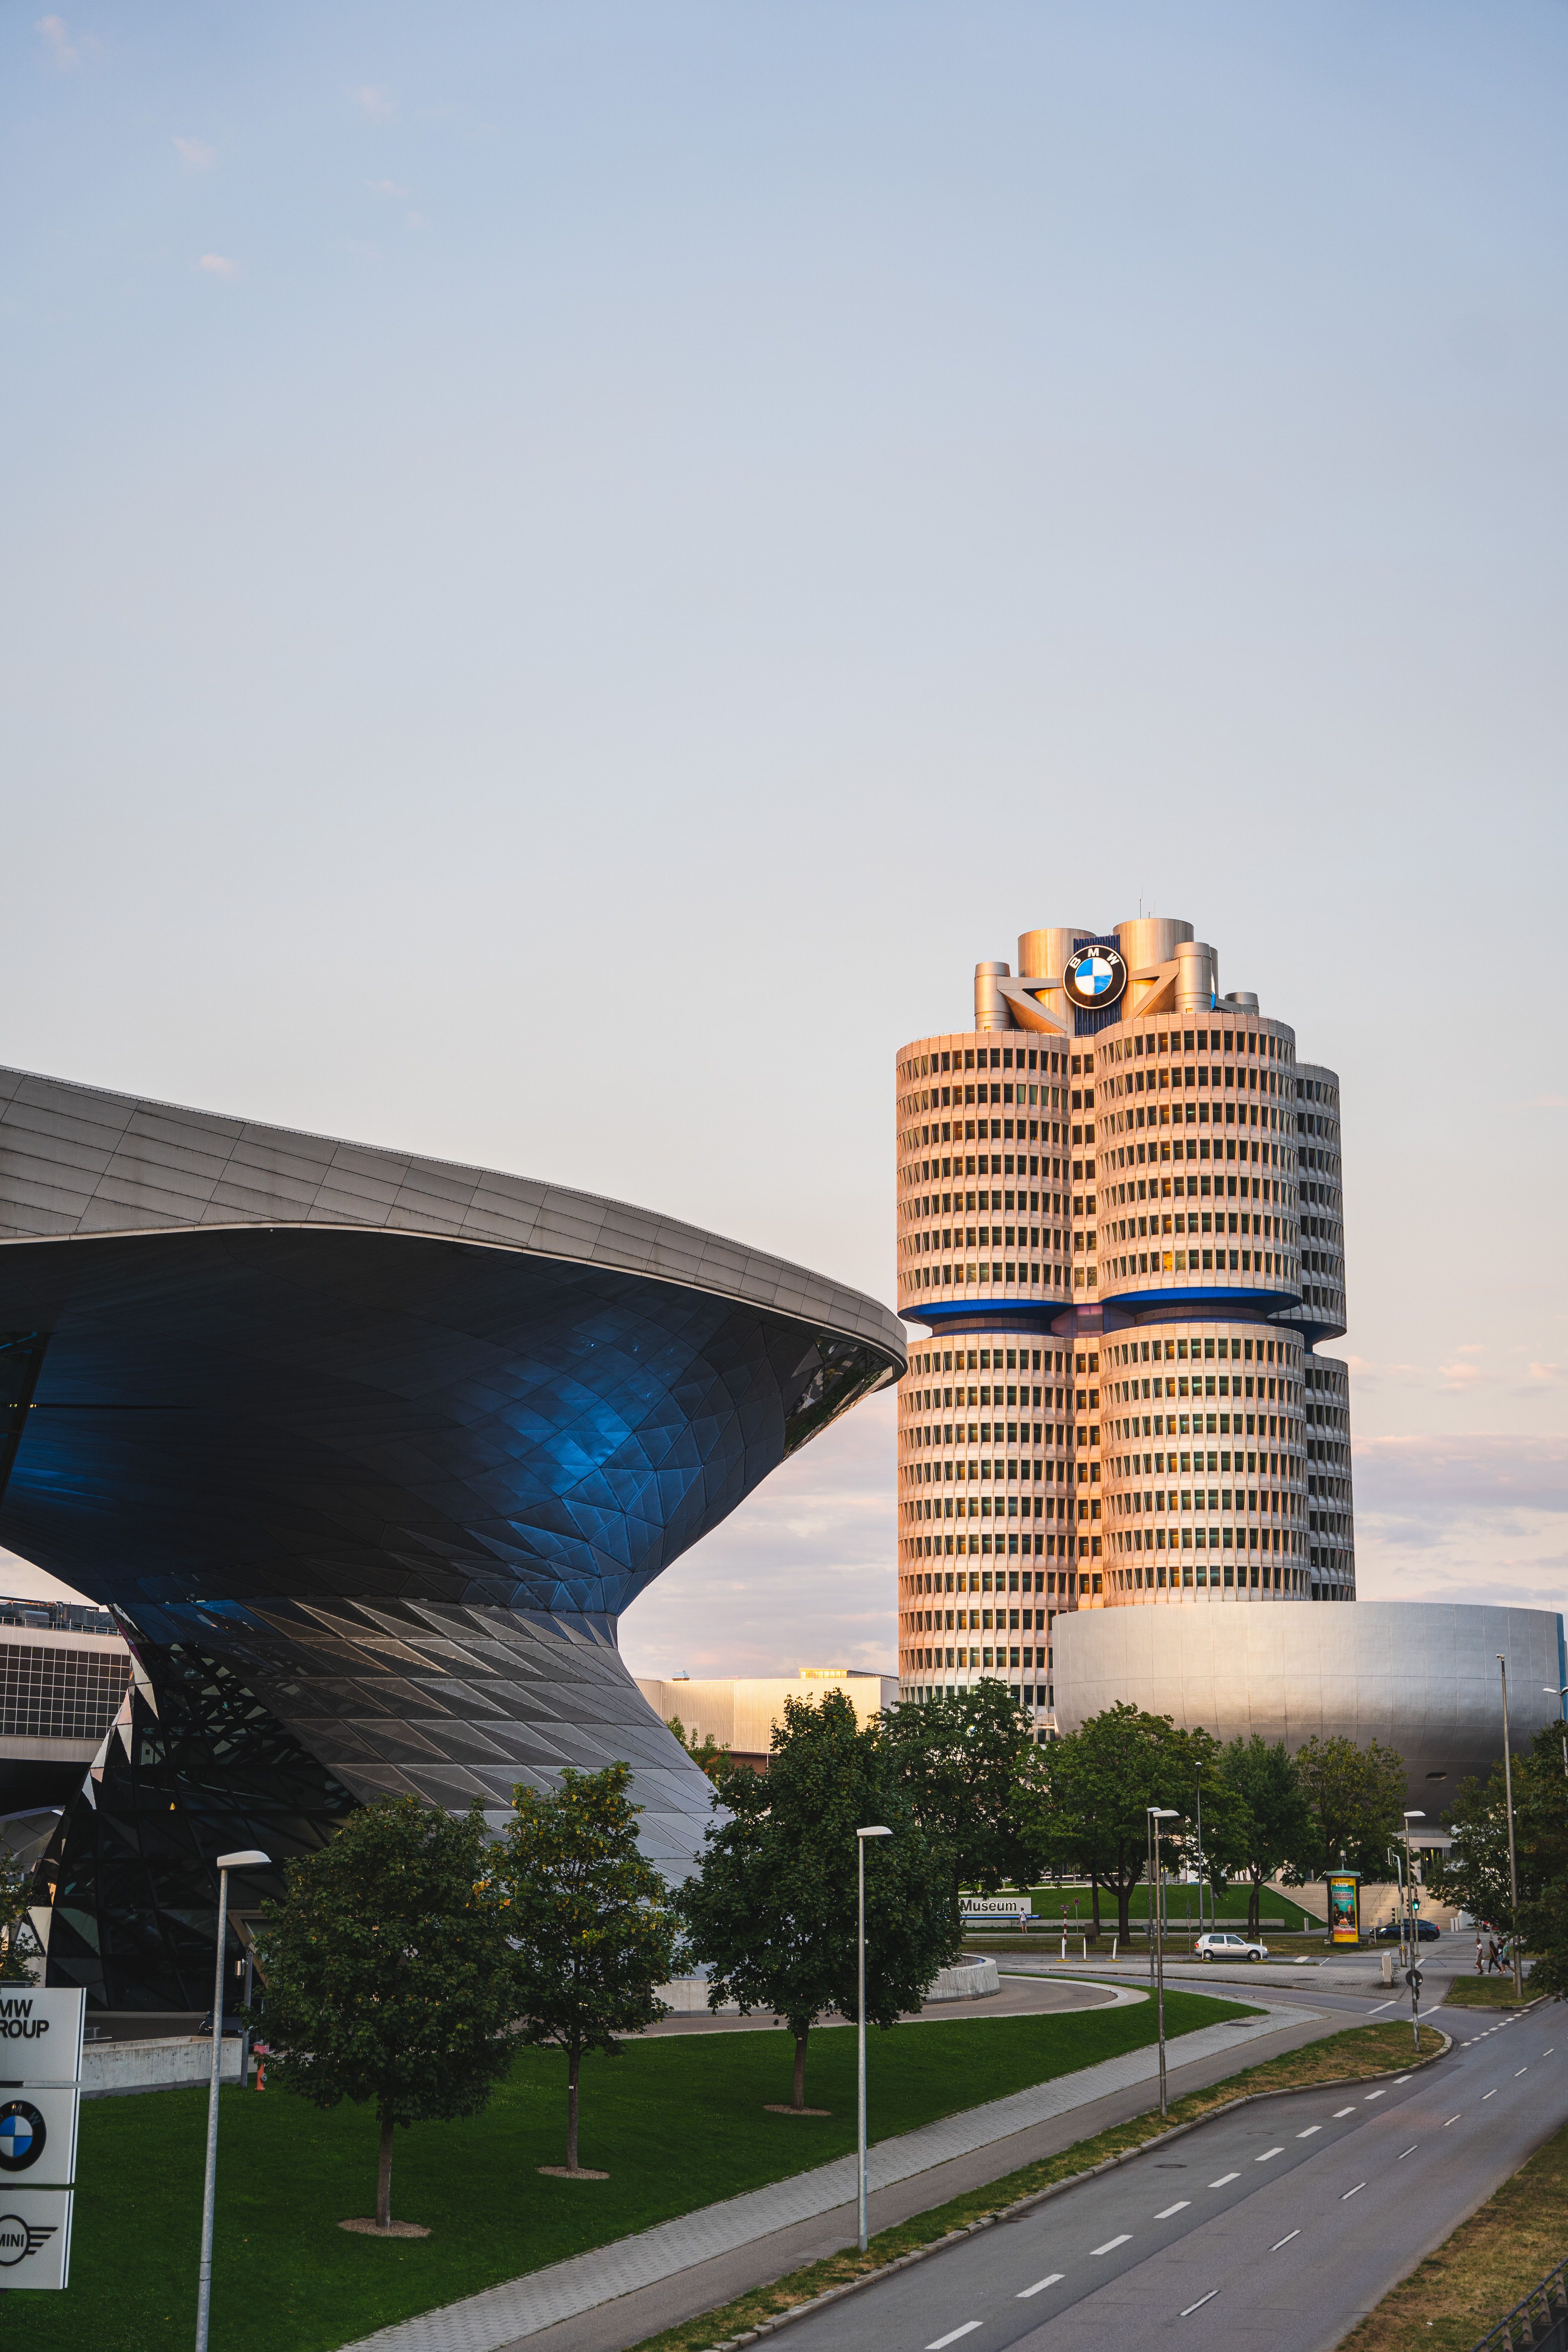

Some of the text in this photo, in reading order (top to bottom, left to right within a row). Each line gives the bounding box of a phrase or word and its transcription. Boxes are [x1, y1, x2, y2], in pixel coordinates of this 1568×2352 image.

[1069, 947, 1120, 969] BMW
[960, 1899, 1016, 1911] Museum
[0, 2000, 33, 2018] MW
[0, 2020, 49, 2038] ROUP
[0, 2103, 41, 2126] MW
